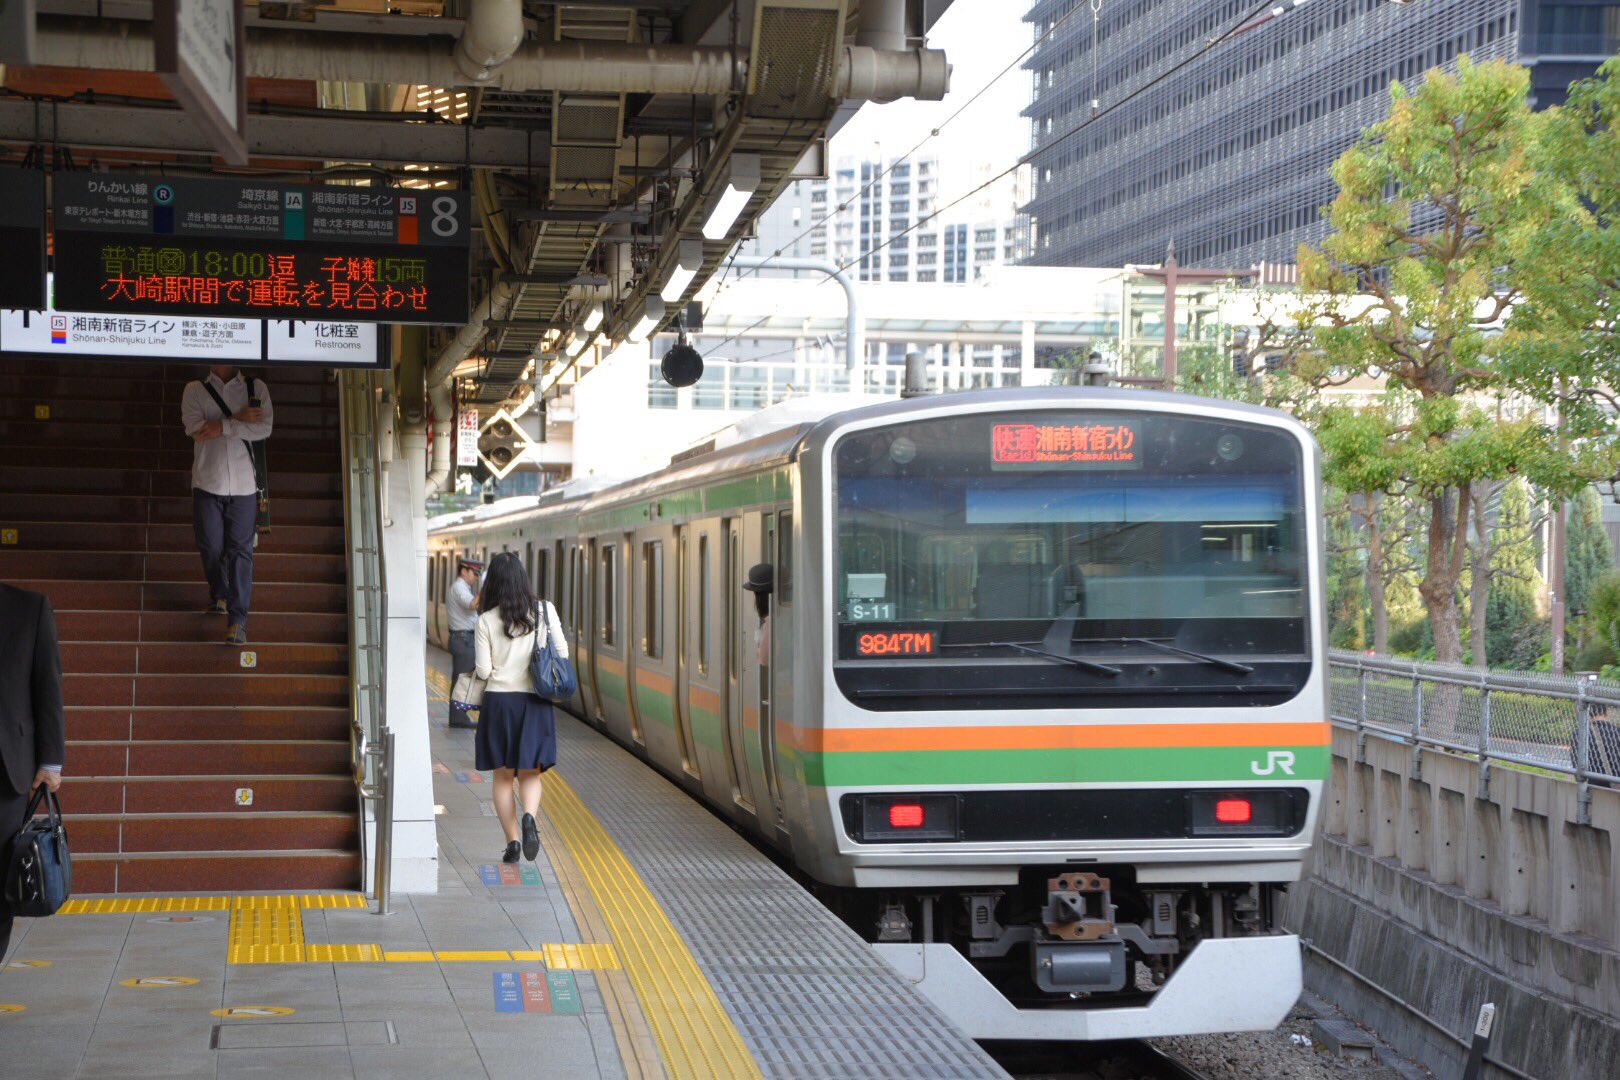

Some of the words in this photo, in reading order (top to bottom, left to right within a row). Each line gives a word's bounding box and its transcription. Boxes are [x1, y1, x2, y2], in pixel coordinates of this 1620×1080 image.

[88, 180, 148, 196] りんかい線
[160, 189, 167, 199] R
[241, 188, 279, 202] 埼京線
[132, 196, 149, 205] Line
[287, 195, 301, 205] JA
[311, 191, 393, 206] 湘南新宿ライン
[402, 200, 414, 211] JS
[378, 208, 394, 216] Line
[431, 196, 459, 237] 8
[100, 245, 155, 275] 普通
[189, 250, 264, 277] 18:00
[72, 316, 176, 334] 湘南新宿ライン
[314, 323, 359, 338] 化粧室
[72, 333, 146, 345] Shōnan-Shinjuku
[148, 335, 167, 345] Line
[314, 340, 362, 349] Restrooms
[996, 427, 1036, 450] 快速
[1036, 425, 1135, 451] 湘南新宿ライン
[999, 449, 1032, 460] Rapid
[1113, 450, 1135, 461] Line
[853, 605, 889, 619] S-11
[859, 632, 932, 654] 9847M
[1251, 751, 1296, 776] JR
